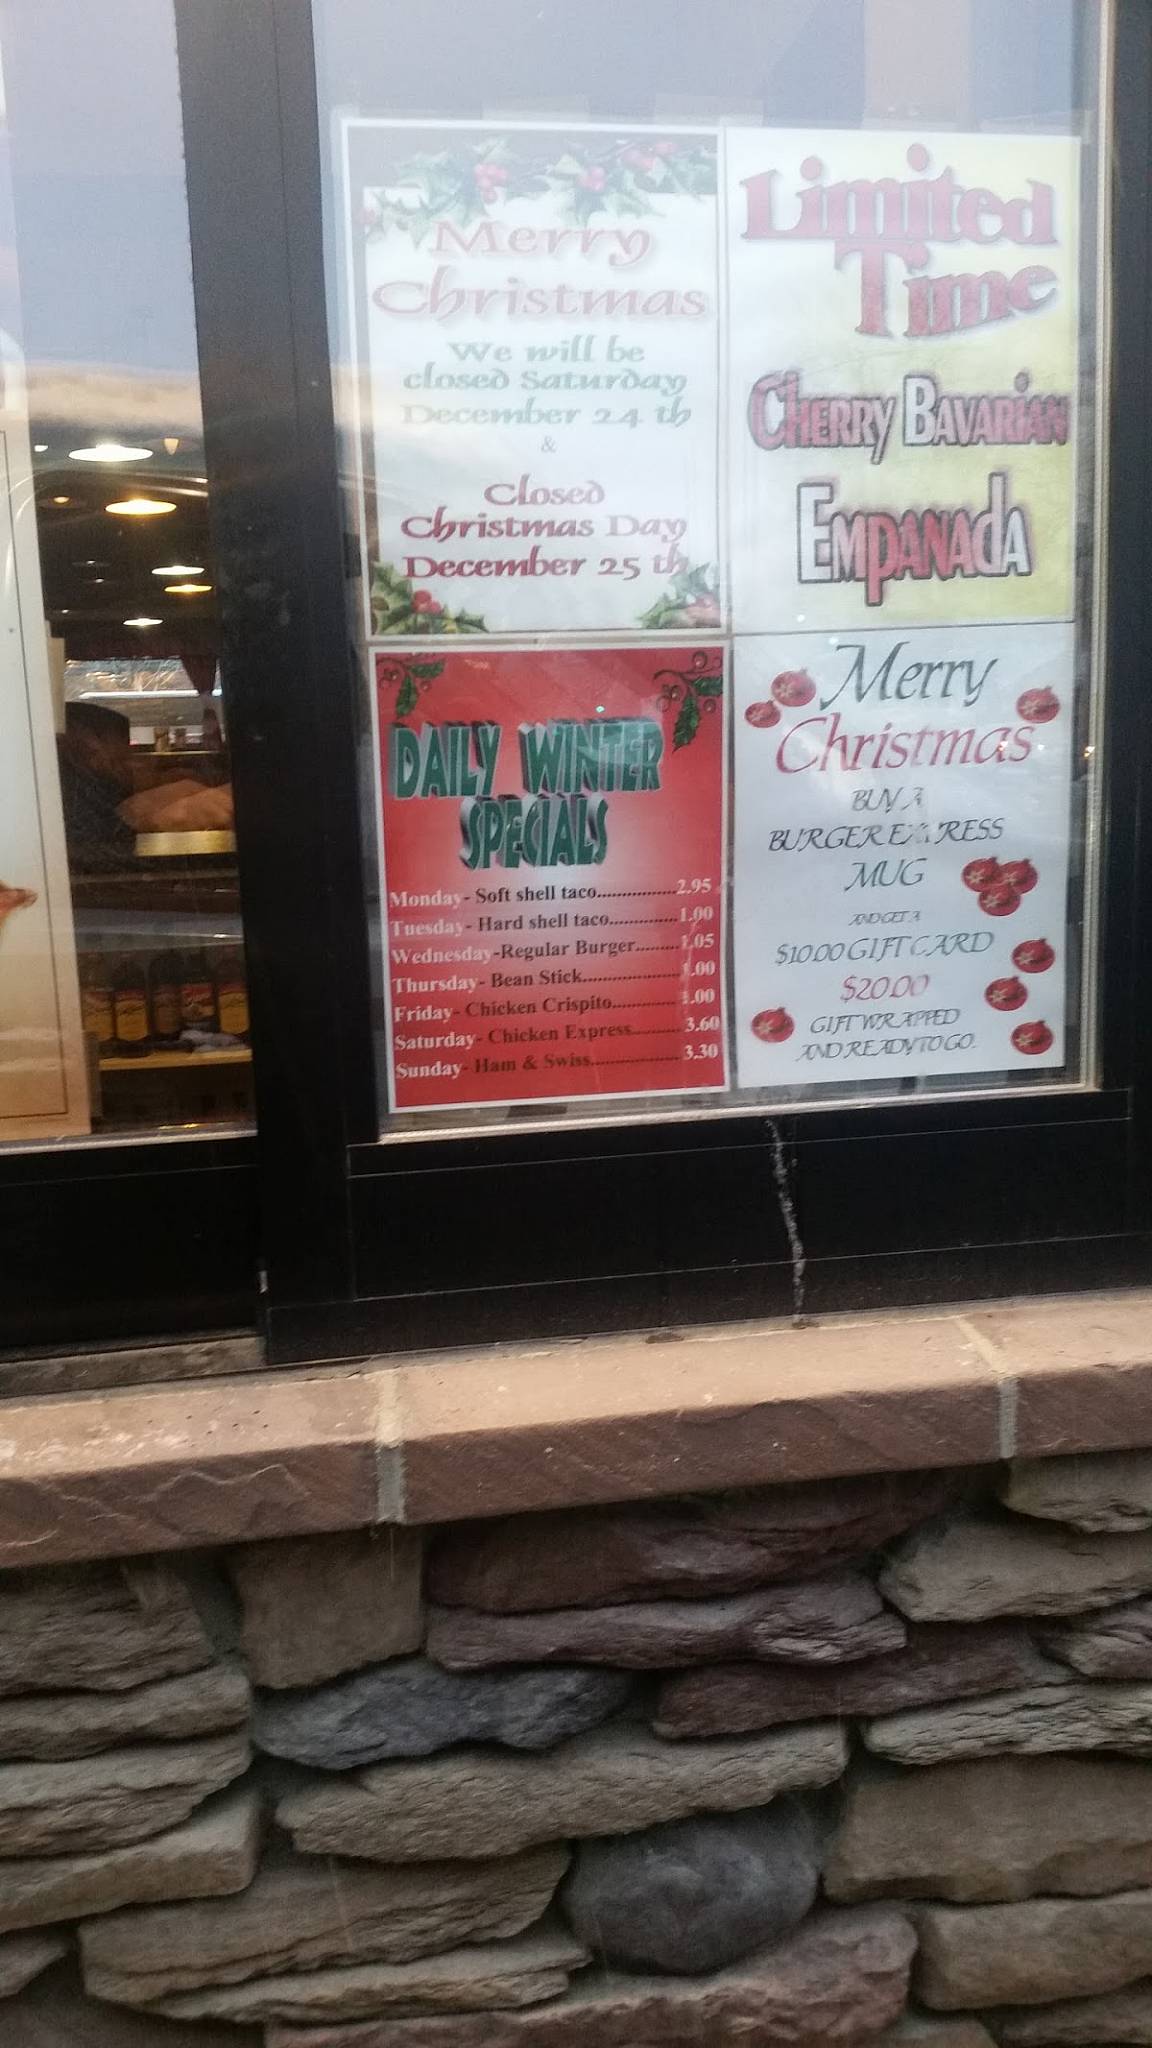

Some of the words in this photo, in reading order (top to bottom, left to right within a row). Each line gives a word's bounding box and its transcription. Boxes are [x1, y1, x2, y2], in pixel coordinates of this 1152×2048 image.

[739, 143, 1059, 245] Limited
[432, 221, 655, 266] Merry
[372, 265, 706, 322] Christmas
[834, 239, 1058, 337] Time
[447, 341, 512, 362] We
[526, 335, 597, 363] will
[606, 335, 645, 362] be
[403, 362, 510, 390] closed
[521, 370, 687, 397] Saturday
[403, 399, 580, 425] December
[592, 406, 643, 428] 24
[657, 398, 691, 427] th
[541, 436, 556, 453] &
[483, 473, 605, 506] Closed
[401, 506, 594, 542] Christmas
[605, 514, 687, 543] Day
[402, 546, 587, 578] December
[599, 558, 640, 580] 25
[653, 544, 689, 577] th
[819, 641, 999, 711] Merry
[389, 720, 502, 800] DAILY
[517, 716, 665, 796] WINTER
[775, 712, 1035, 774] Christmas
[459, 792, 610, 870] SPECIALS
[768, 826, 883, 852] BURGER
[888, 817, 1005, 847] EXRESS
[475, 886, 510, 903] Soft
[515, 885, 556, 901] shell
[676, 878, 712, 895] 2.95
[843, 857, 927, 892] MUG
[478, 917, 525, 932] Hard
[528, 912, 568, 929] shell
[680, 906, 714, 923] 1.00
[848, 935, 910, 962] GIFT
[909, 931, 995, 958] CARD
[491, 972, 534, 988] Bean
[840, 974, 931, 1003] $20.00
[465, 997, 537, 1018] Chicken
[488, 1025, 559, 1044] Chicken
[685, 1016, 720, 1034] 3.60
[809, 1015, 862, 1035] GIFT
[475, 1055, 517, 1074] Ham
[522, 1054, 540, 1070] &
[684, 1043, 719, 1061] 3.30
[795, 1041, 845, 1062] AND
